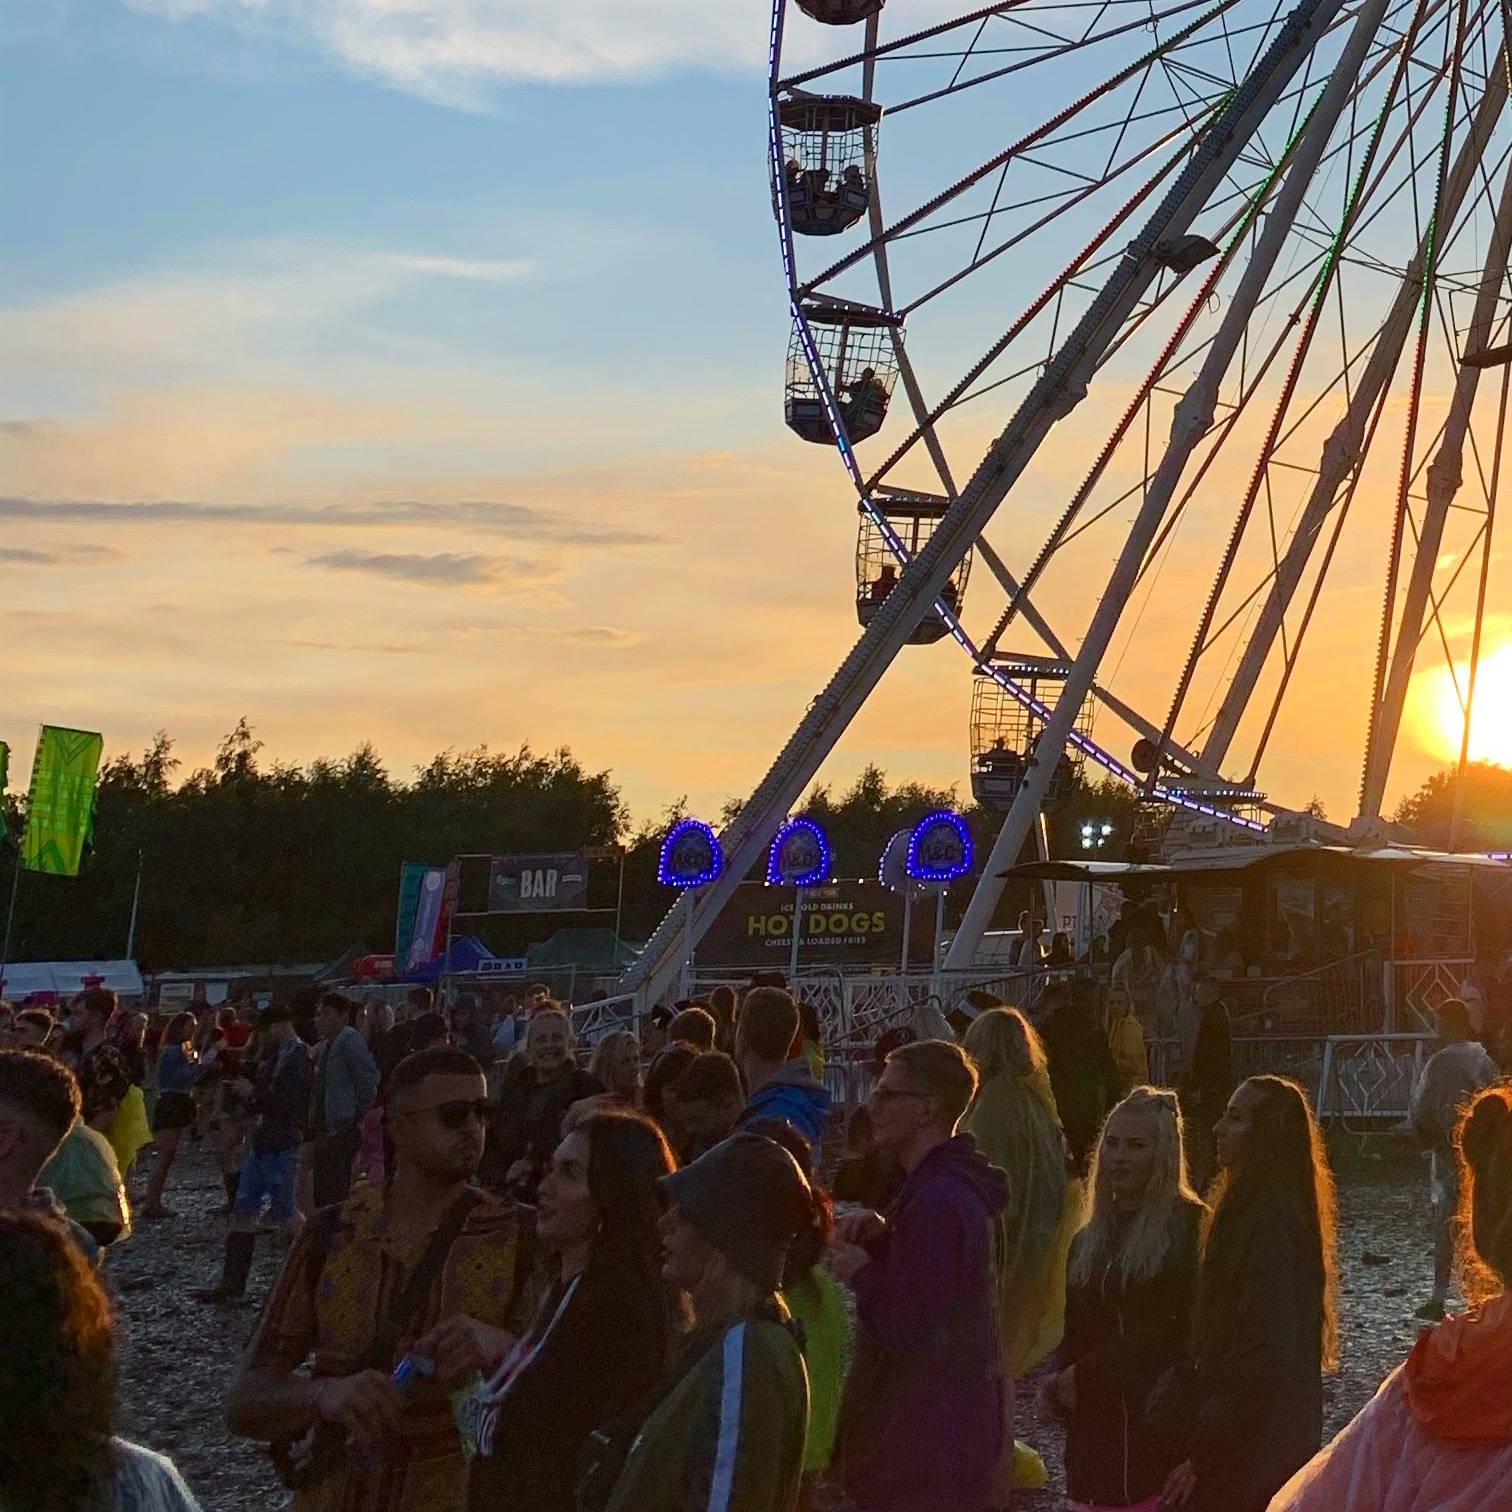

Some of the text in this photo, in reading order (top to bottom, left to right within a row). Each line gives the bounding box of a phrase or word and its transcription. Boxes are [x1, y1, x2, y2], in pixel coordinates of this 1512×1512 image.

[520, 869, 557, 898] BAR
[780, 902, 854, 912] ICE OLD DRINKS
[808, 912, 886, 934] DOGS
[806, 936, 842, 946] LOADED
[843, 936, 866, 945] FRIES
